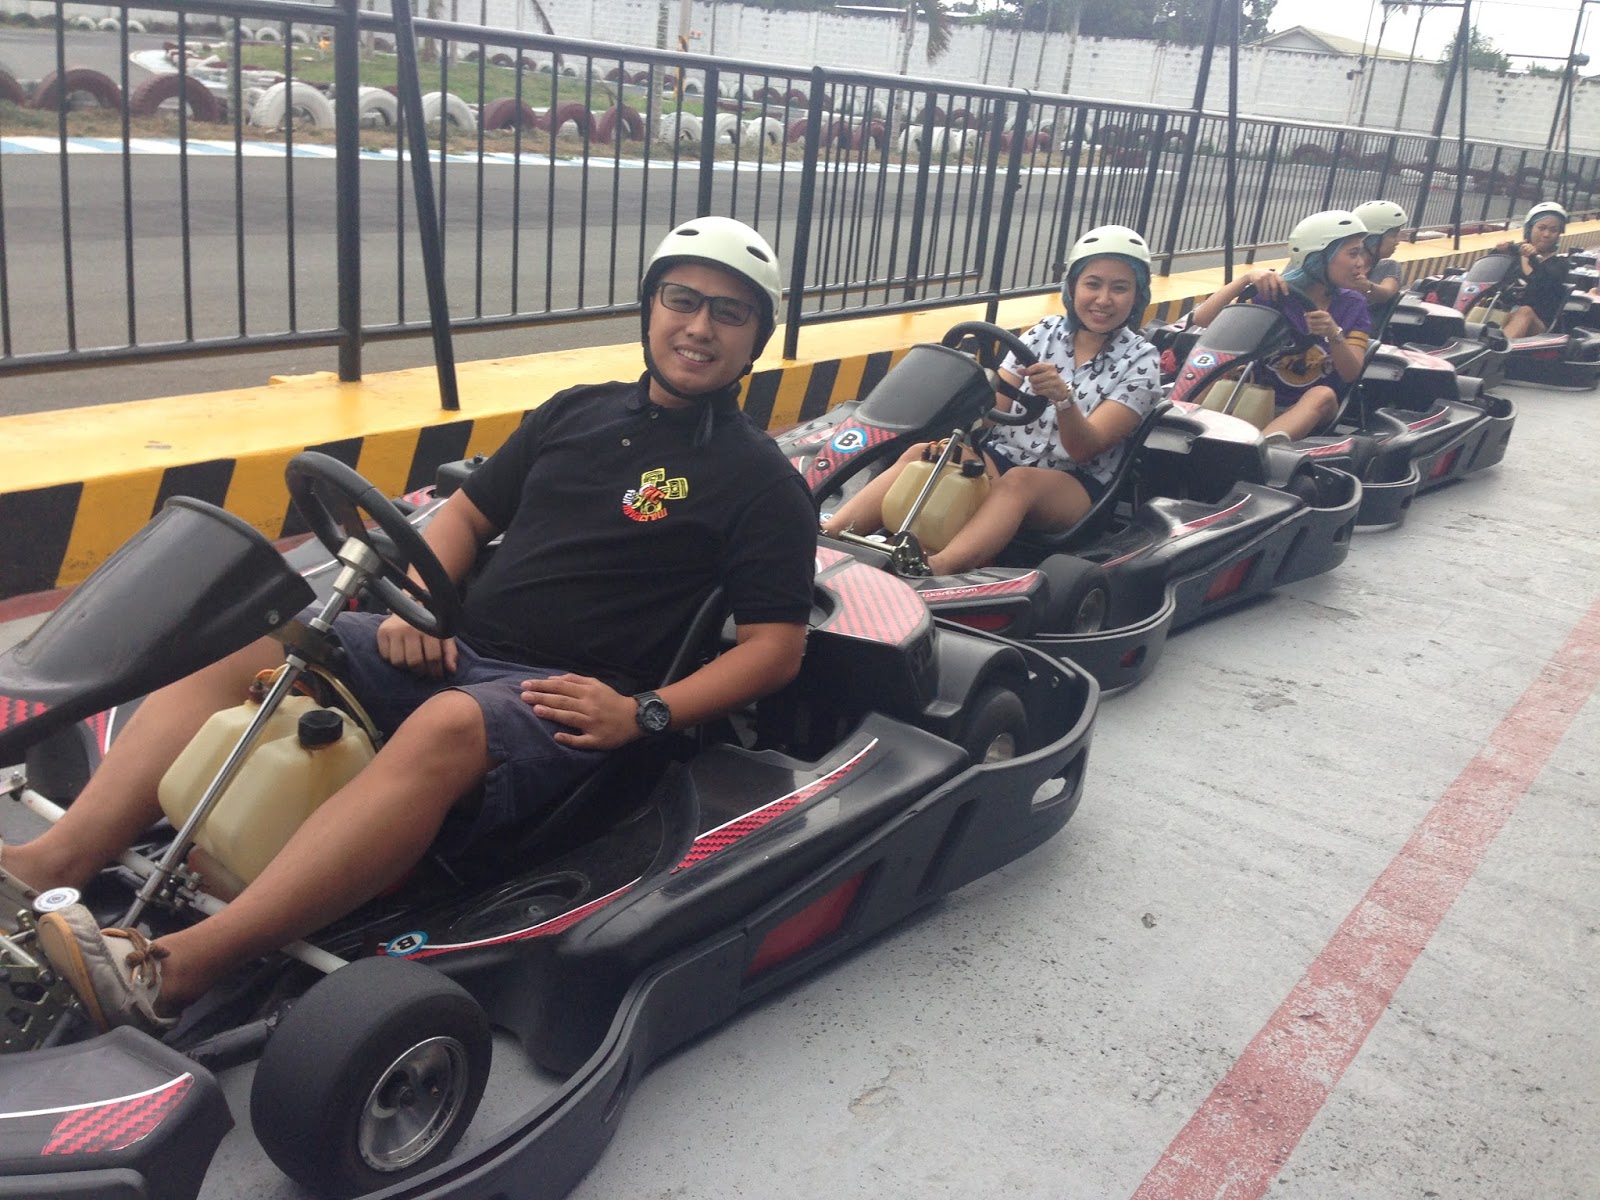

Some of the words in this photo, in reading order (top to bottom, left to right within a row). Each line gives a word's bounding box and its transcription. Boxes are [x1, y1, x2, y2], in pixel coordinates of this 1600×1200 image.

[1197, 356, 1210, 364] B
[838, 433, 857, 446] B
[397, 936, 416, 950] B
